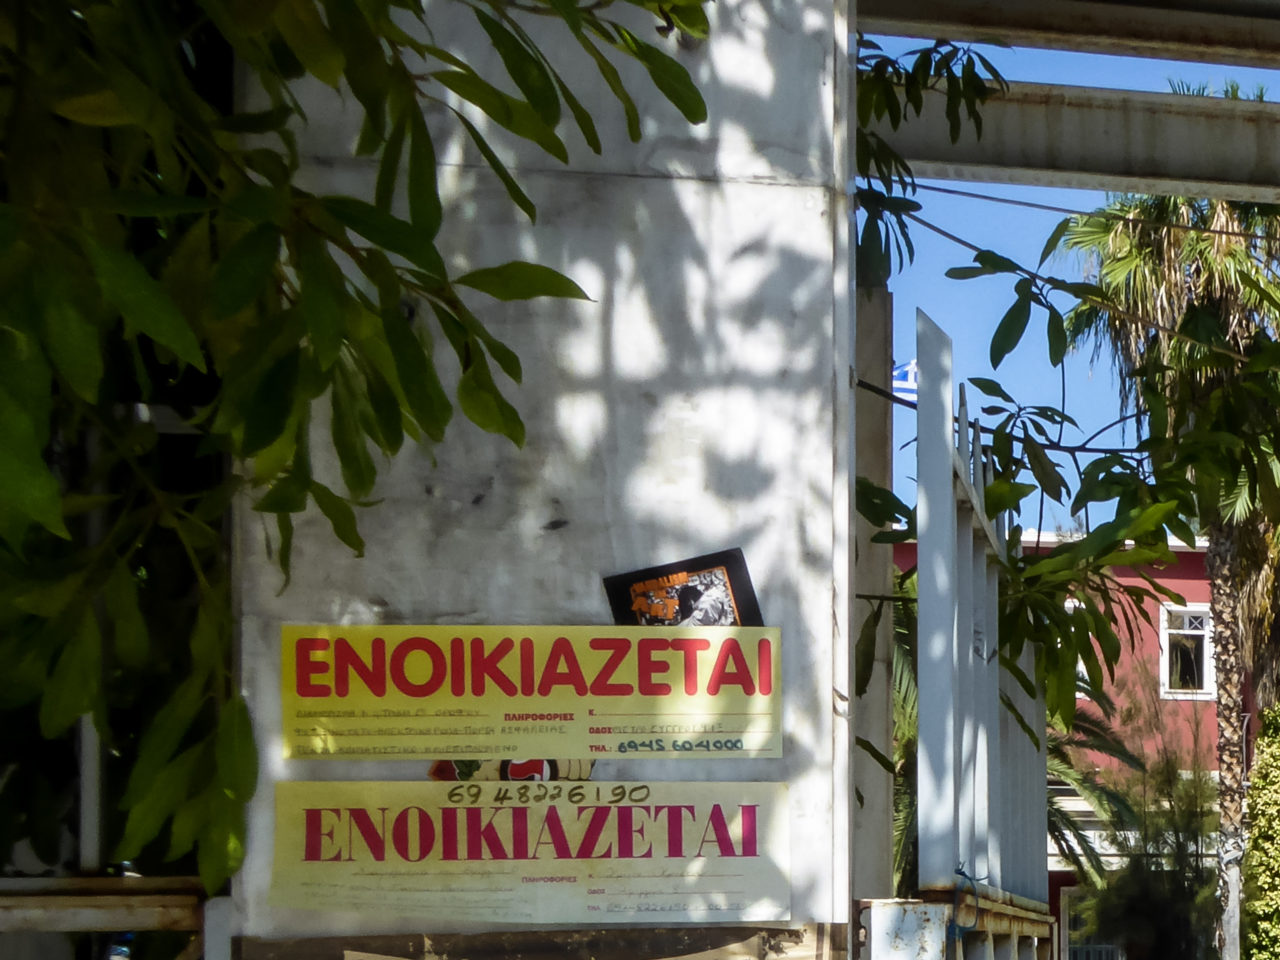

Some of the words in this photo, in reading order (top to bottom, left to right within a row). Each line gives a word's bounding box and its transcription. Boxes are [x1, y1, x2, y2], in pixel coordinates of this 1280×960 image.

[295, 637, 772, 697] ΕΝΟΙΚΙΑΖΕΤΑΙ
[504, 712, 575, 722] ΠΛΗΡΟΦΟΡΙΕΣ
[302, 804, 761, 862] ΕΝΟΙΚΙΑΖΕΤΑΙ
